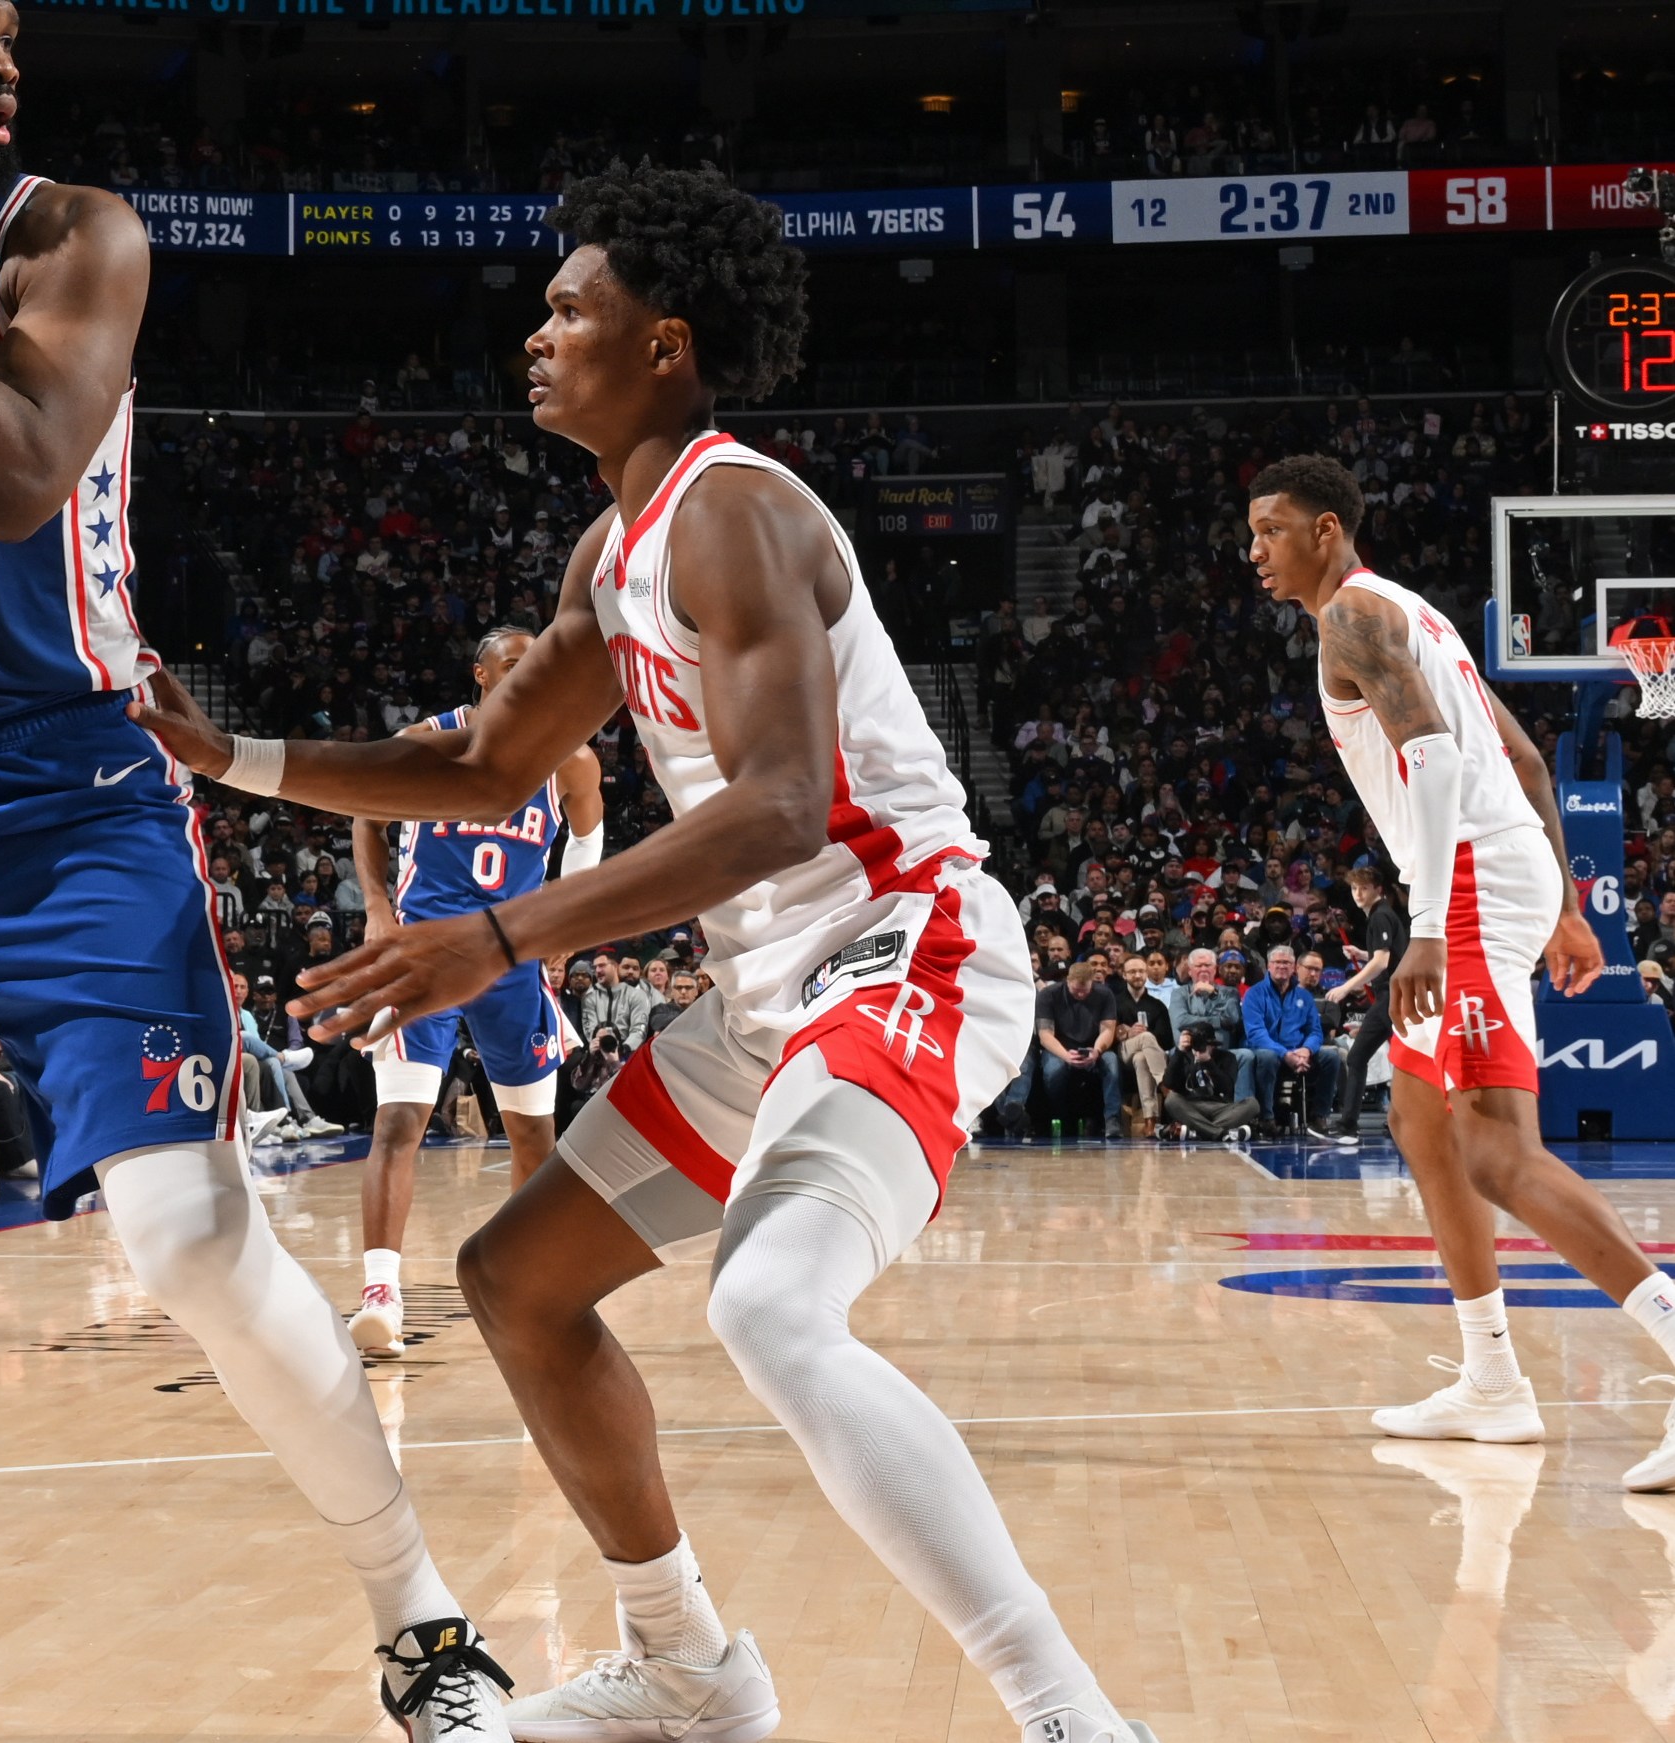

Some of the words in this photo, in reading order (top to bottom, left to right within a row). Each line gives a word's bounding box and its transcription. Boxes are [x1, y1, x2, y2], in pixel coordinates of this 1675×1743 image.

[130, 193, 199, 214] TICKETS
[205, 196, 253, 216] NOW!
[303, 205, 374, 220] PLAYER
[388, 205, 401, 220] 0
[425, 205, 436, 220] 9
[455, 206, 475, 220] 21
[489, 206, 512, 221] 25
[524, 206, 547, 221] 77
[1012, 191, 1076, 240] 54
[1130, 198, 1167, 227] 12
[1219, 180, 1331, 233] 2:37
[1348, 192, 1395, 216] 2ND
[1446, 176, 1508, 225] 58
[169, 219, 246, 248] $7,324
[304, 230, 372, 245] POINTS
[390, 231, 401, 246] 6
[422, 232, 440, 246] 13
[456, 231, 474, 246] 13
[495, 231, 505, 246] 7
[530, 231, 540, 246] 7
[780, 211, 857, 237] ELPHIA
[867, 207, 945, 235] 76ERS
[1608, 293, 1675, 327] 2:3
[1622, 330, 1675, 392] 12
[877, 487, 916, 504] Hard
[917, 486, 954, 506] Rock
[877, 514, 908, 532] 108
[928, 514, 948, 529] EXIT
[970, 513, 998, 531] 107
[472, 841, 507, 890] 0
[532, 1034, 558, 1069] 76
[140, 1054, 216, 1116] 76
